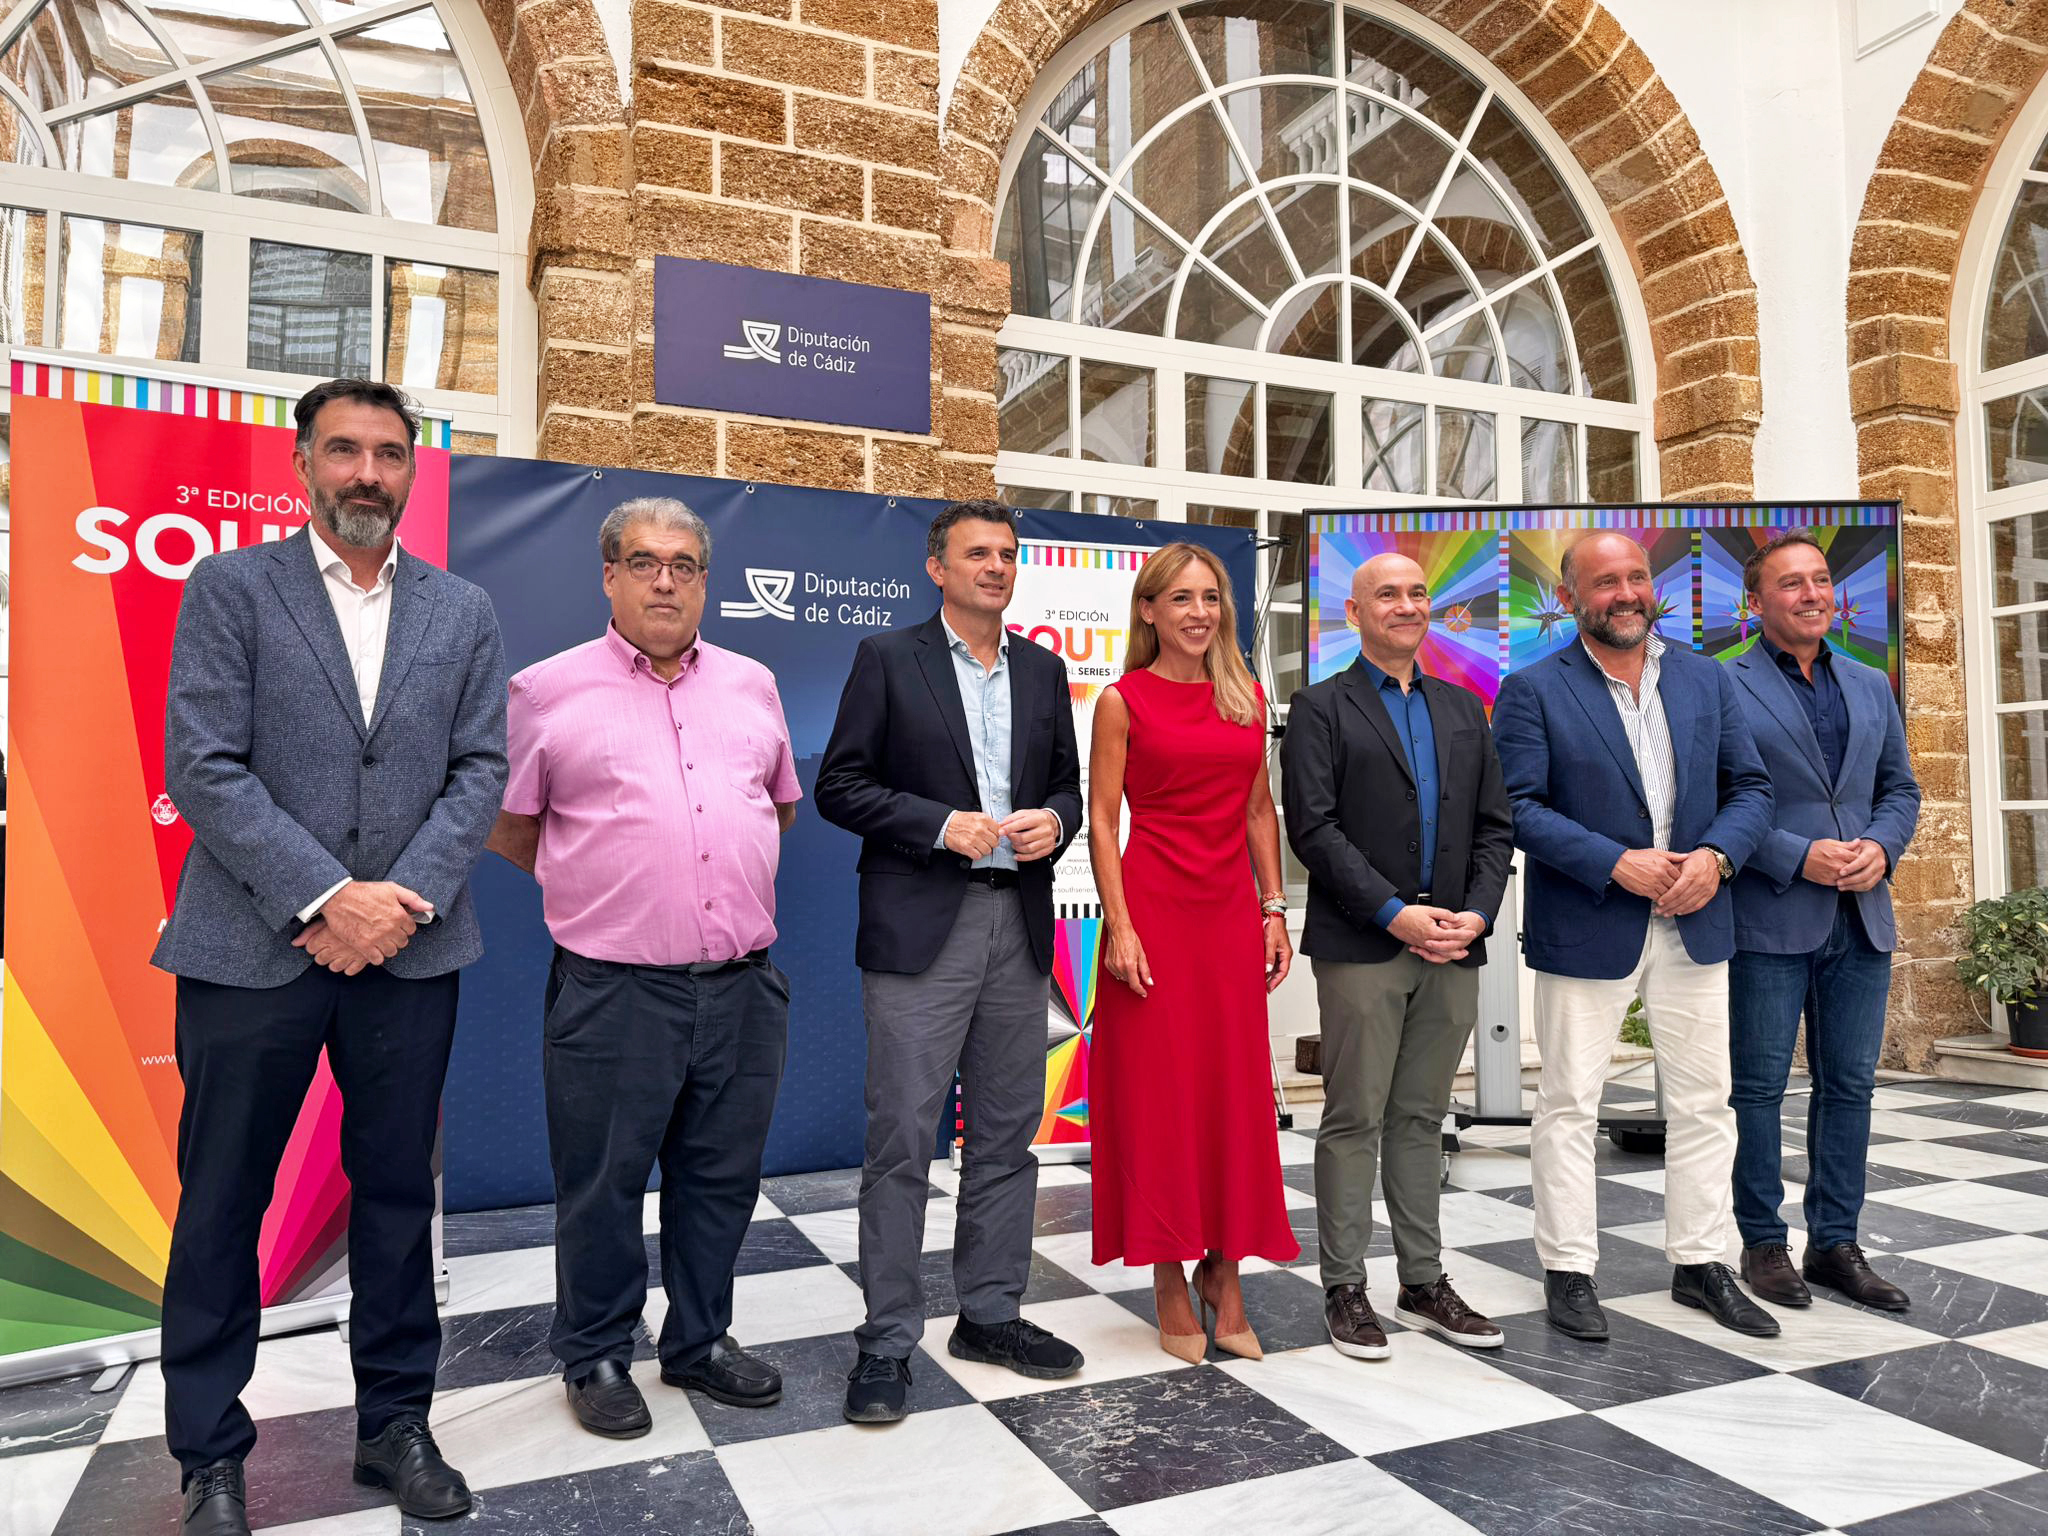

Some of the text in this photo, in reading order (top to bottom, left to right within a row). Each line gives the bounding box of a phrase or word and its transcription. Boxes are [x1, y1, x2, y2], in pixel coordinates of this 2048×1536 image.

[788, 326, 870, 352] Diputación
[788, 350, 856, 374] de Cádiz
[207, 488, 312, 516] EDICIÓN
[805, 572, 910, 599] Diputación
[805, 602, 892, 627] de Cádiz
[1059, 610, 1109, 622] EDICIÓN
[1006, 623, 1130, 662] OUT
[1078, 667, 1111, 677] SERIES
[1054, 865, 1092, 876] WOMA
